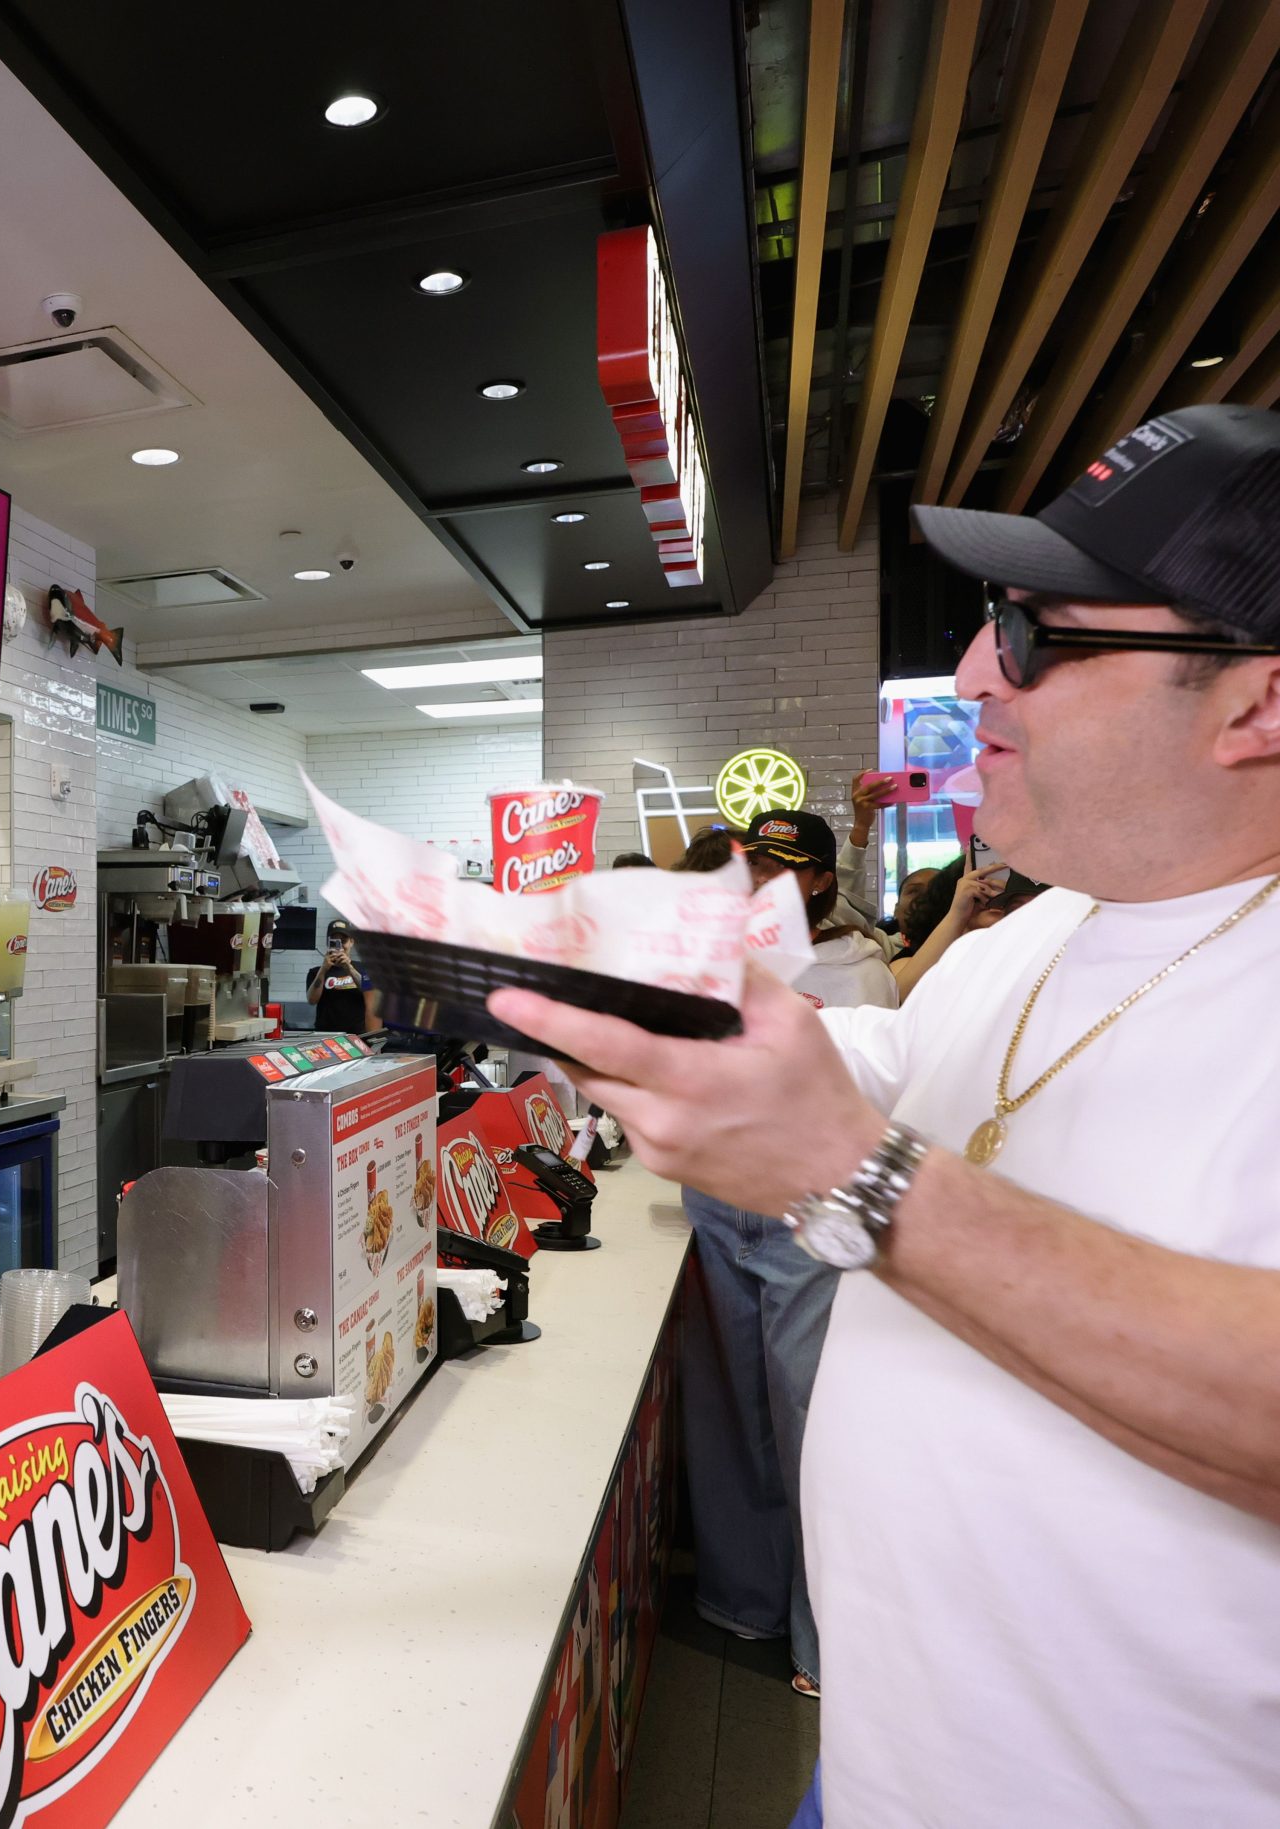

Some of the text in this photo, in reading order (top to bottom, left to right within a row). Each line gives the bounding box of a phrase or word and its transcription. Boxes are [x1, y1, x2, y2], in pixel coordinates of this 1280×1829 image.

[98, 688, 153, 736] TIMES SQ
[759, 819, 800, 836] Cane's
[34, 866, 78, 910] Cane's
[502, 840, 582, 895] Cane's
[336, 1107, 359, 1132] COMBOS
[337, 1152, 348, 1172] THE
[348, 1148, 359, 1166] BOX
[45, 1584, 181, 1744] CHICKEN FINGERS
